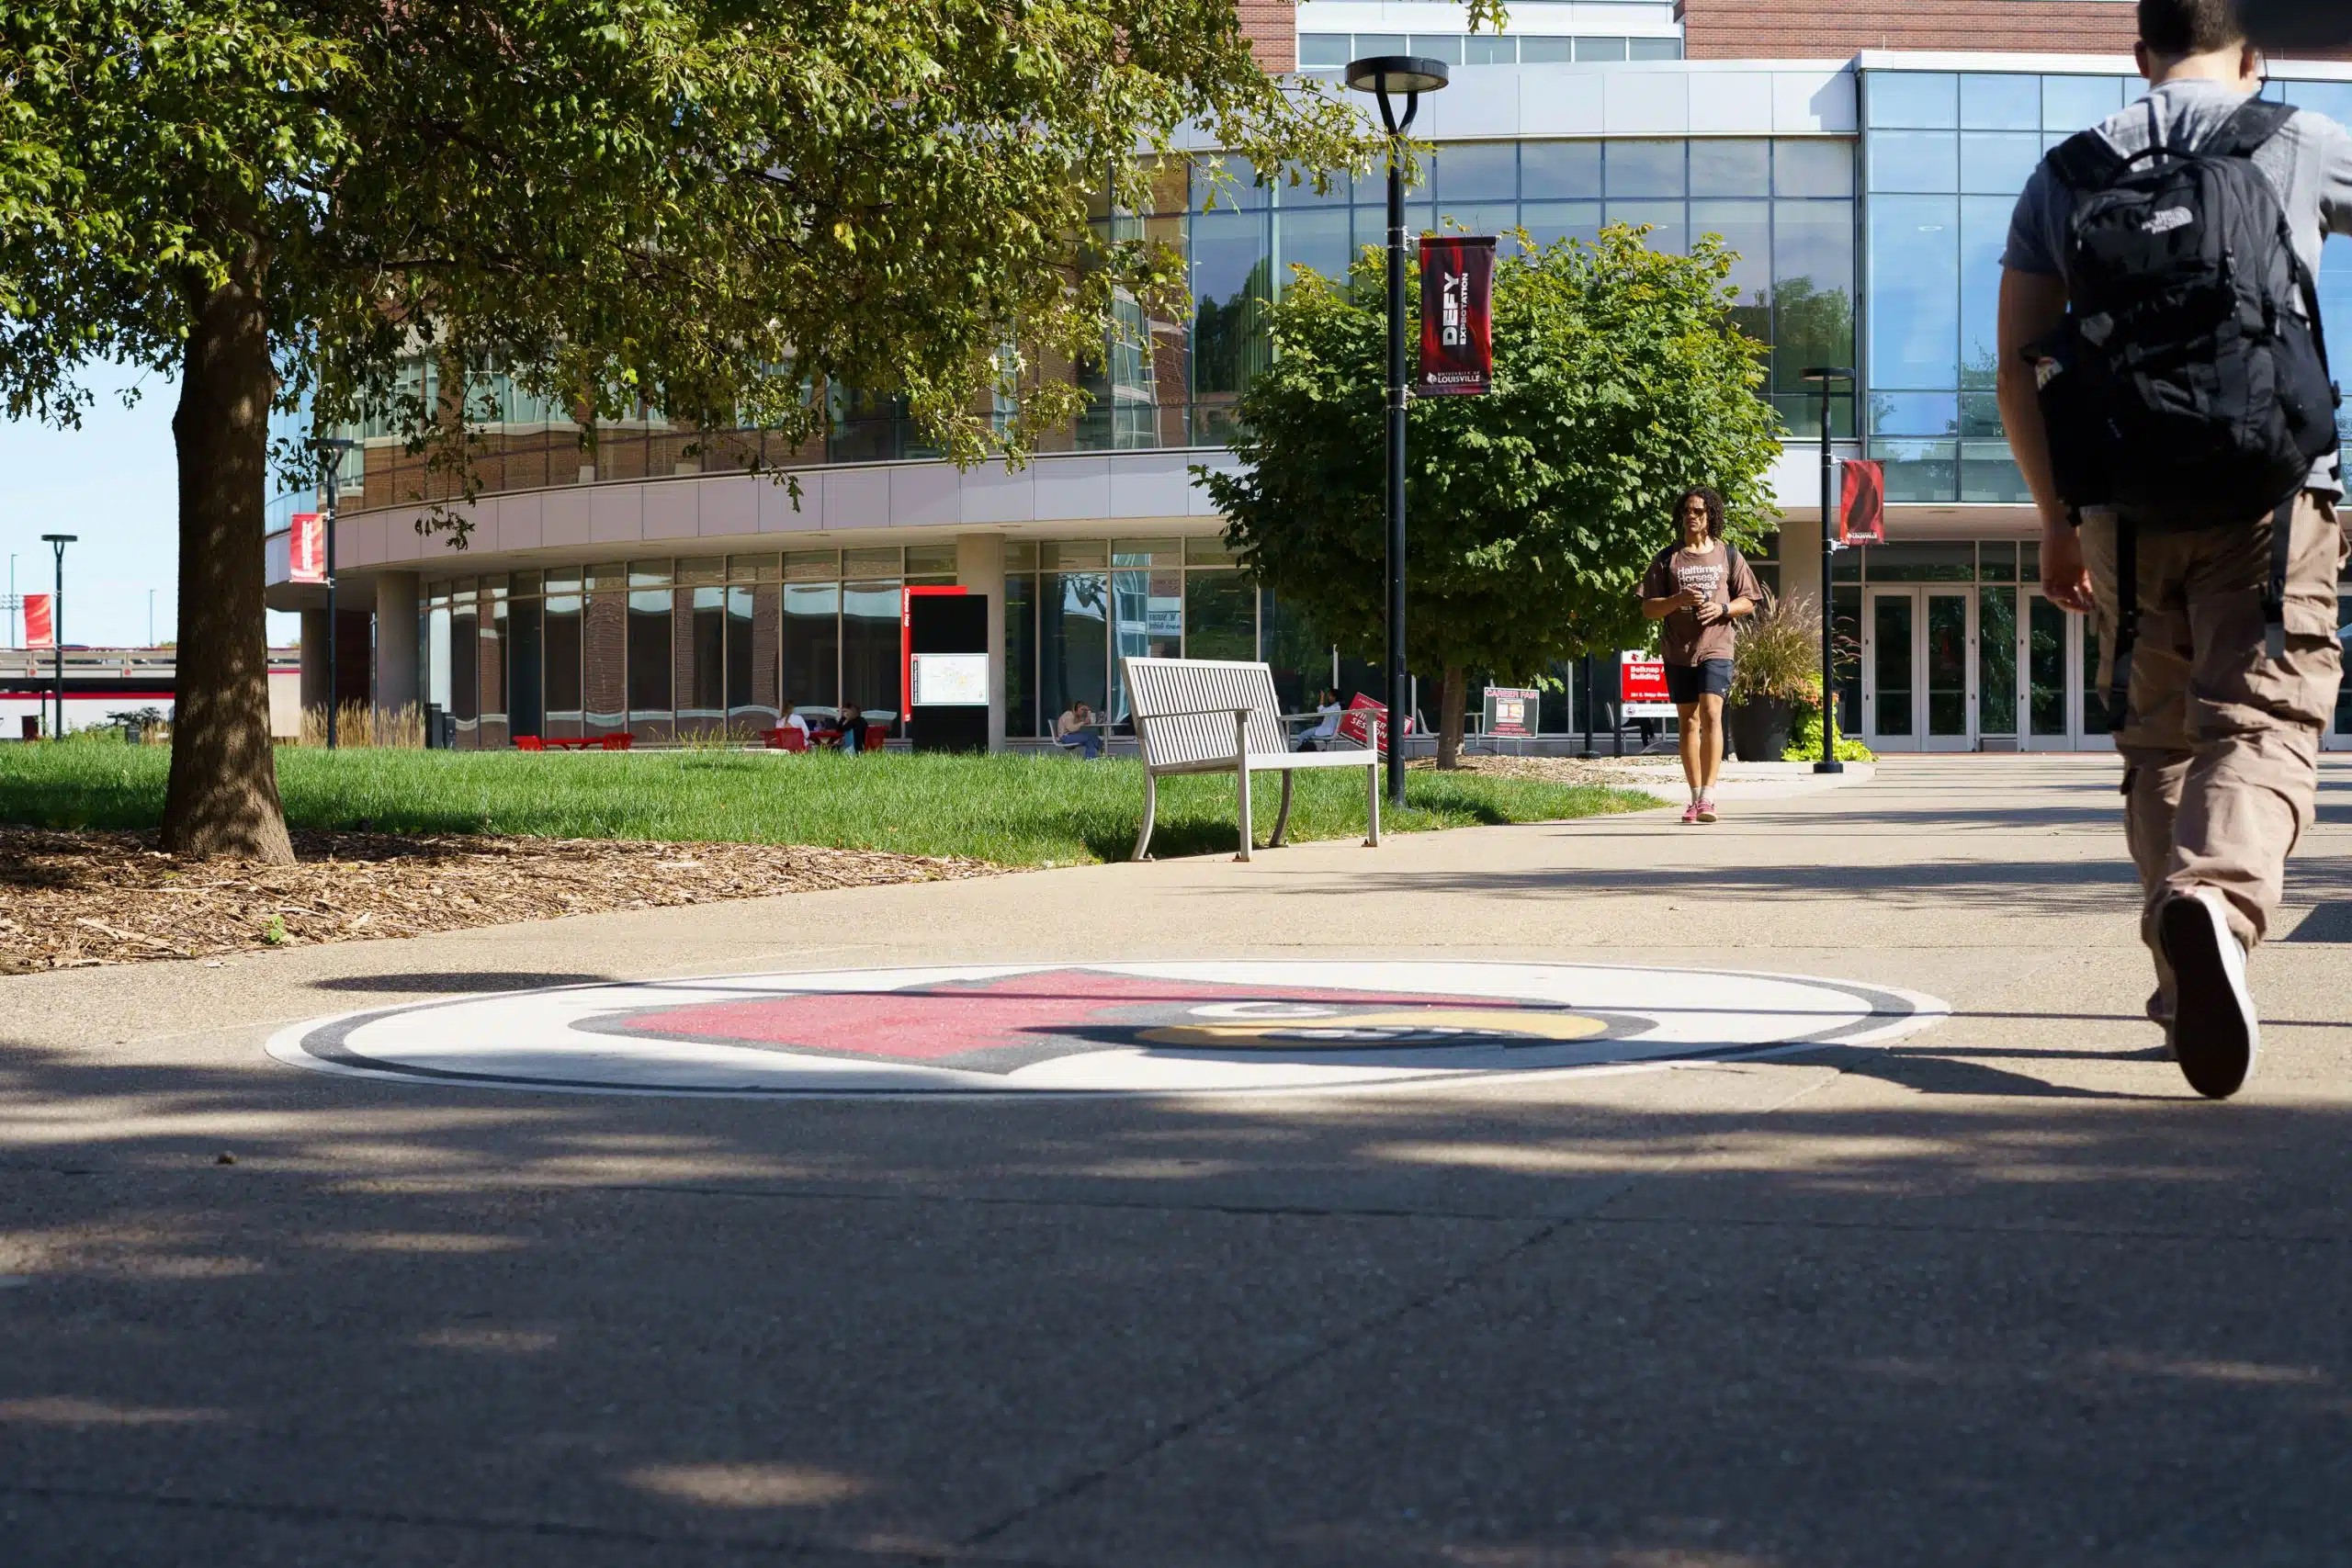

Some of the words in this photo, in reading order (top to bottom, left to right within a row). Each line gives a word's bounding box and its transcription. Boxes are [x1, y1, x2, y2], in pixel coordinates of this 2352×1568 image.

[1443, 272, 1459, 345] DEFY
[1460, 272, 1469, 345] EXPECTATION
[1437, 375, 1480, 383] LOUISVILLE
